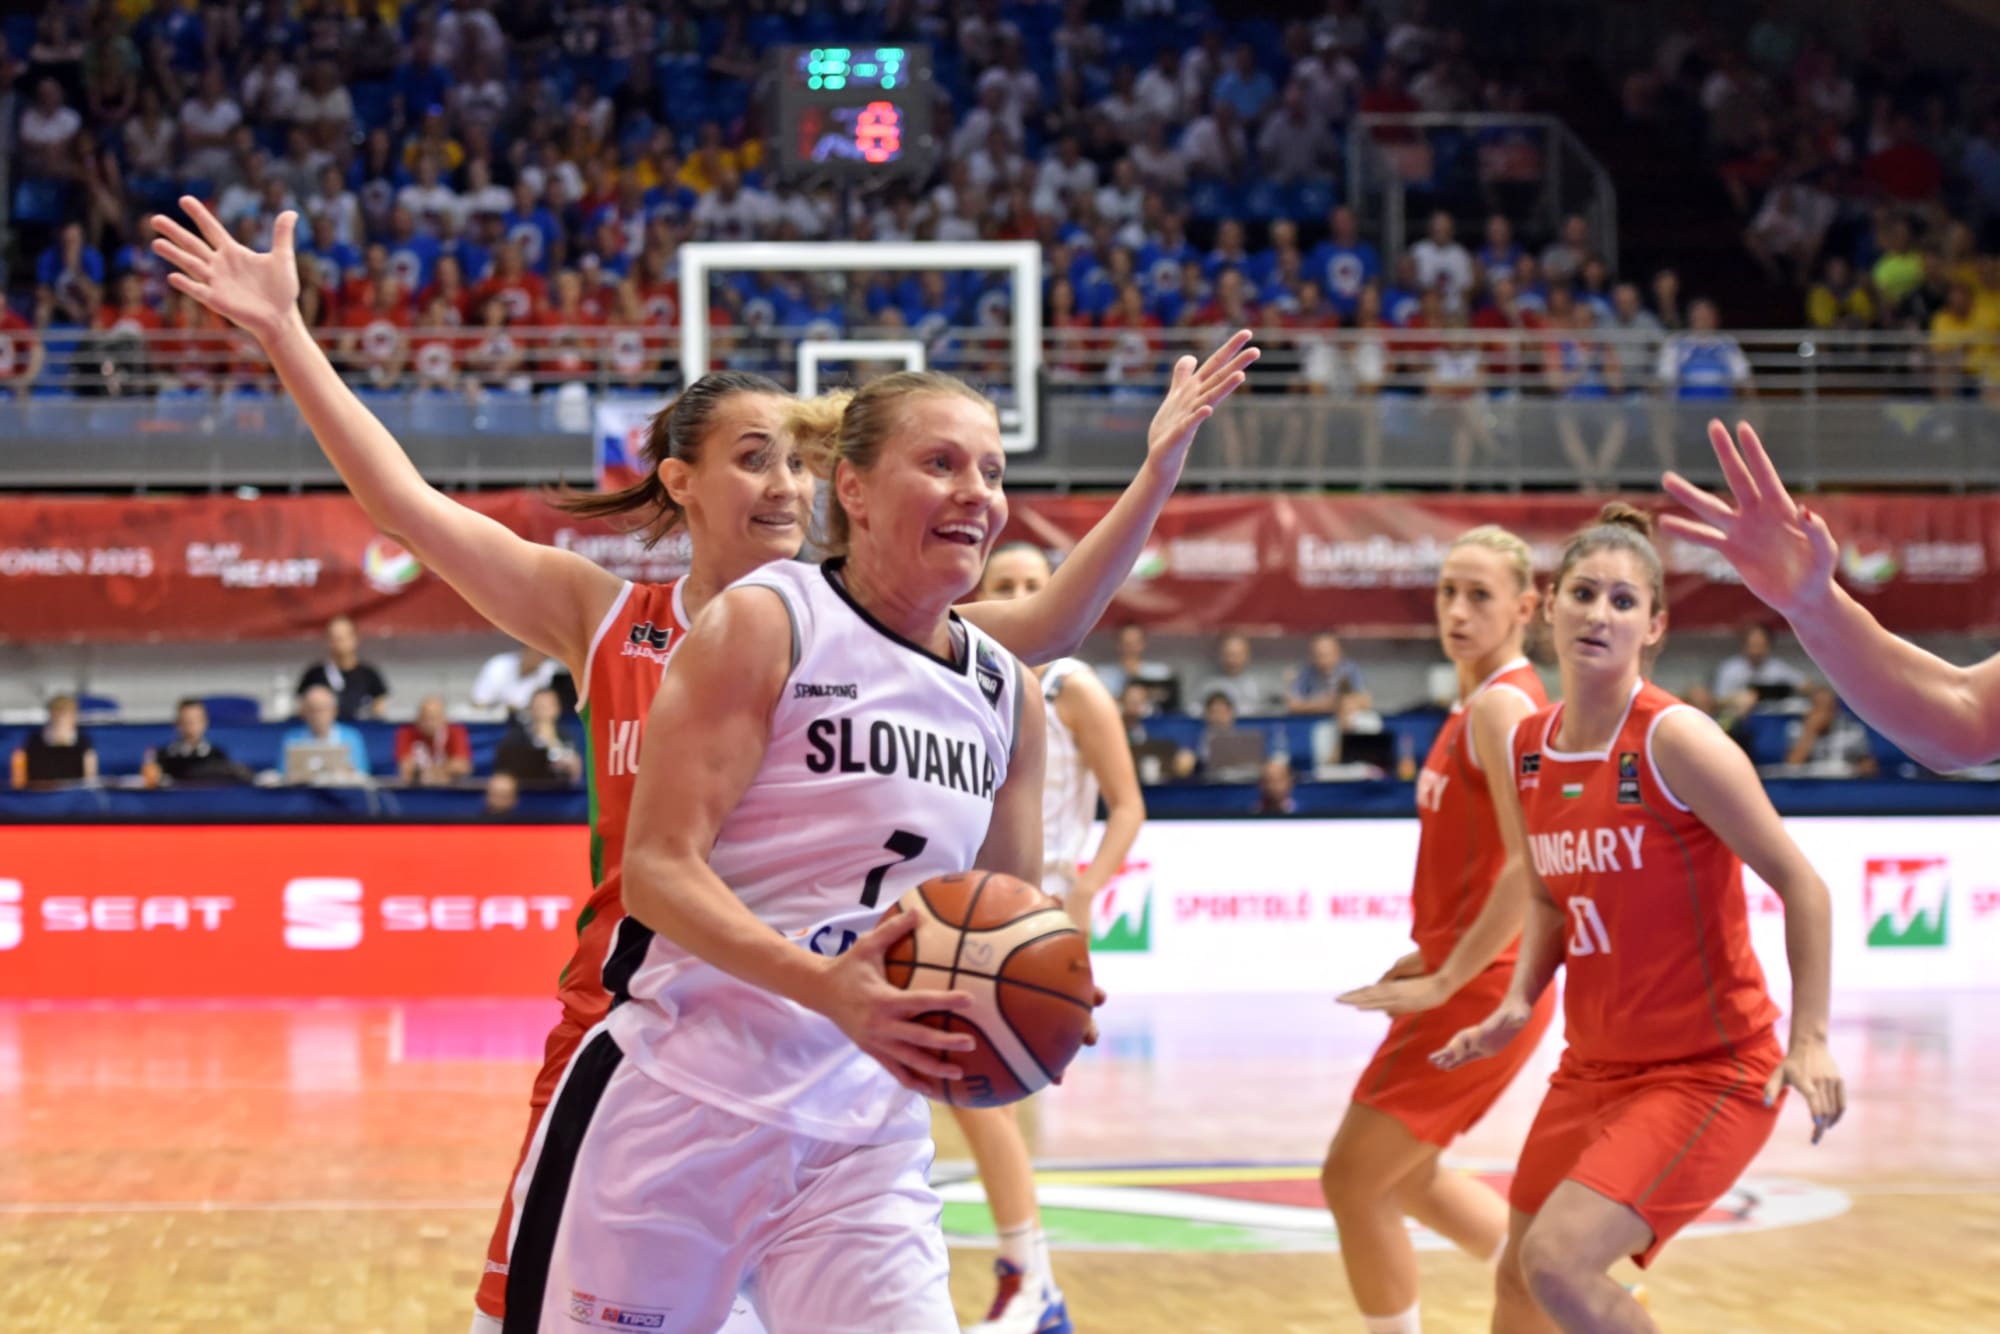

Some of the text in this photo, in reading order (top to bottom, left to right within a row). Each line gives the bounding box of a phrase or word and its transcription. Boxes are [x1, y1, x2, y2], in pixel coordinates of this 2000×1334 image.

[221, 558, 321, 588] HEART
[793, 682, 858, 700] SPALDING
[806, 718, 995, 802] SLOVAKIA
[860, 829, 928, 909] 7
[41, 896, 234, 931] SEAT
[380, 896, 573, 931] SEAT
